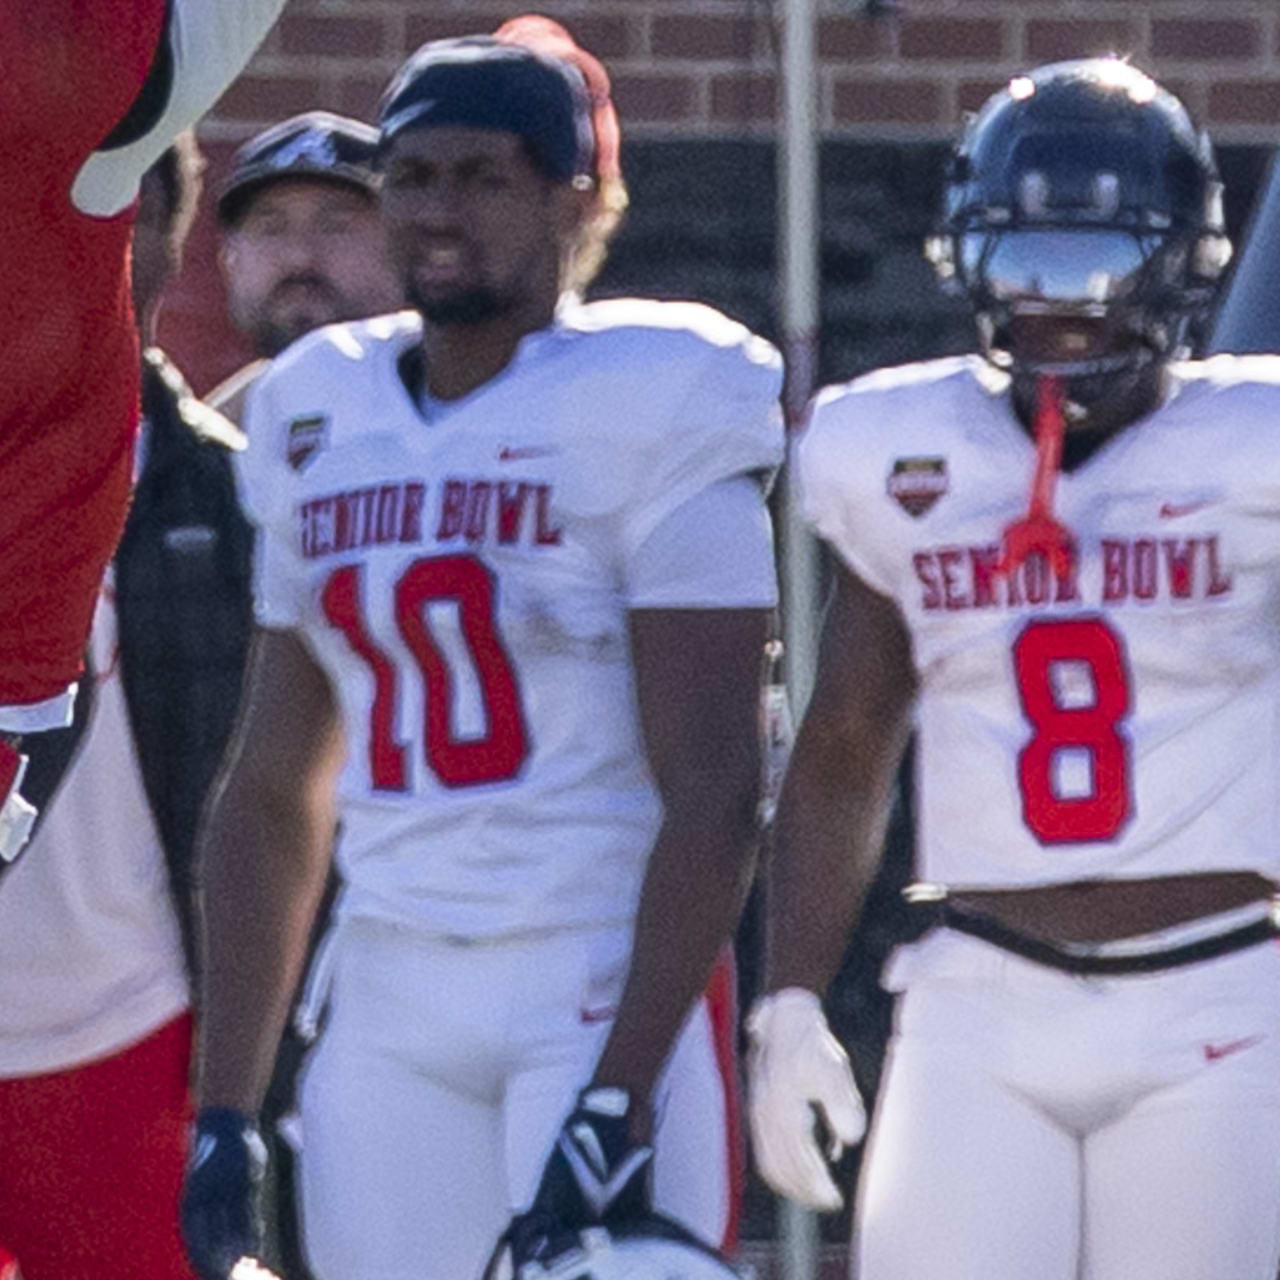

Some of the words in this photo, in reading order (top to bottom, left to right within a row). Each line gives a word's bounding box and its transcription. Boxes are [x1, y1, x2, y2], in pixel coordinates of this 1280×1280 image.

[438, 478, 563, 548] BOWL
[1100, 532, 1234, 606] BOWL
[320, 552, 532, 794] 10
[1011, 613, 1137, 847] 8
